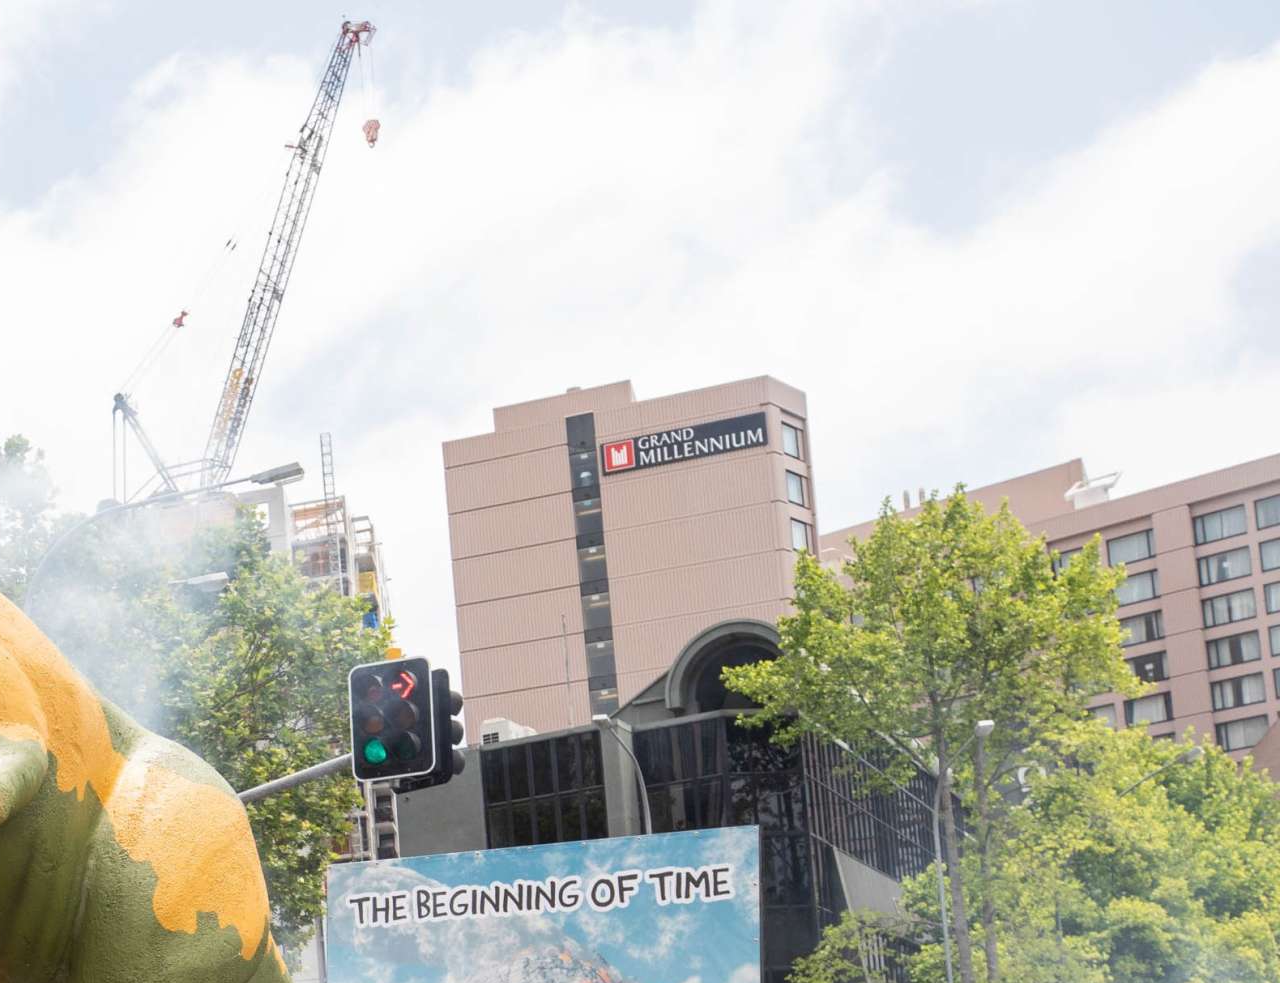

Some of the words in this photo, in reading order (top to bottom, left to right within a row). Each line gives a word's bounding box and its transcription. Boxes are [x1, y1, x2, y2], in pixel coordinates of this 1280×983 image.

[638, 427, 694, 450] GRAND
[639, 427, 765, 466] MILLENNIUM
[350, 895, 407, 924] THE
[419, 880, 579, 918] BEGINNING
[591, 874, 638, 906] OF
[649, 867, 731, 900] TIME
